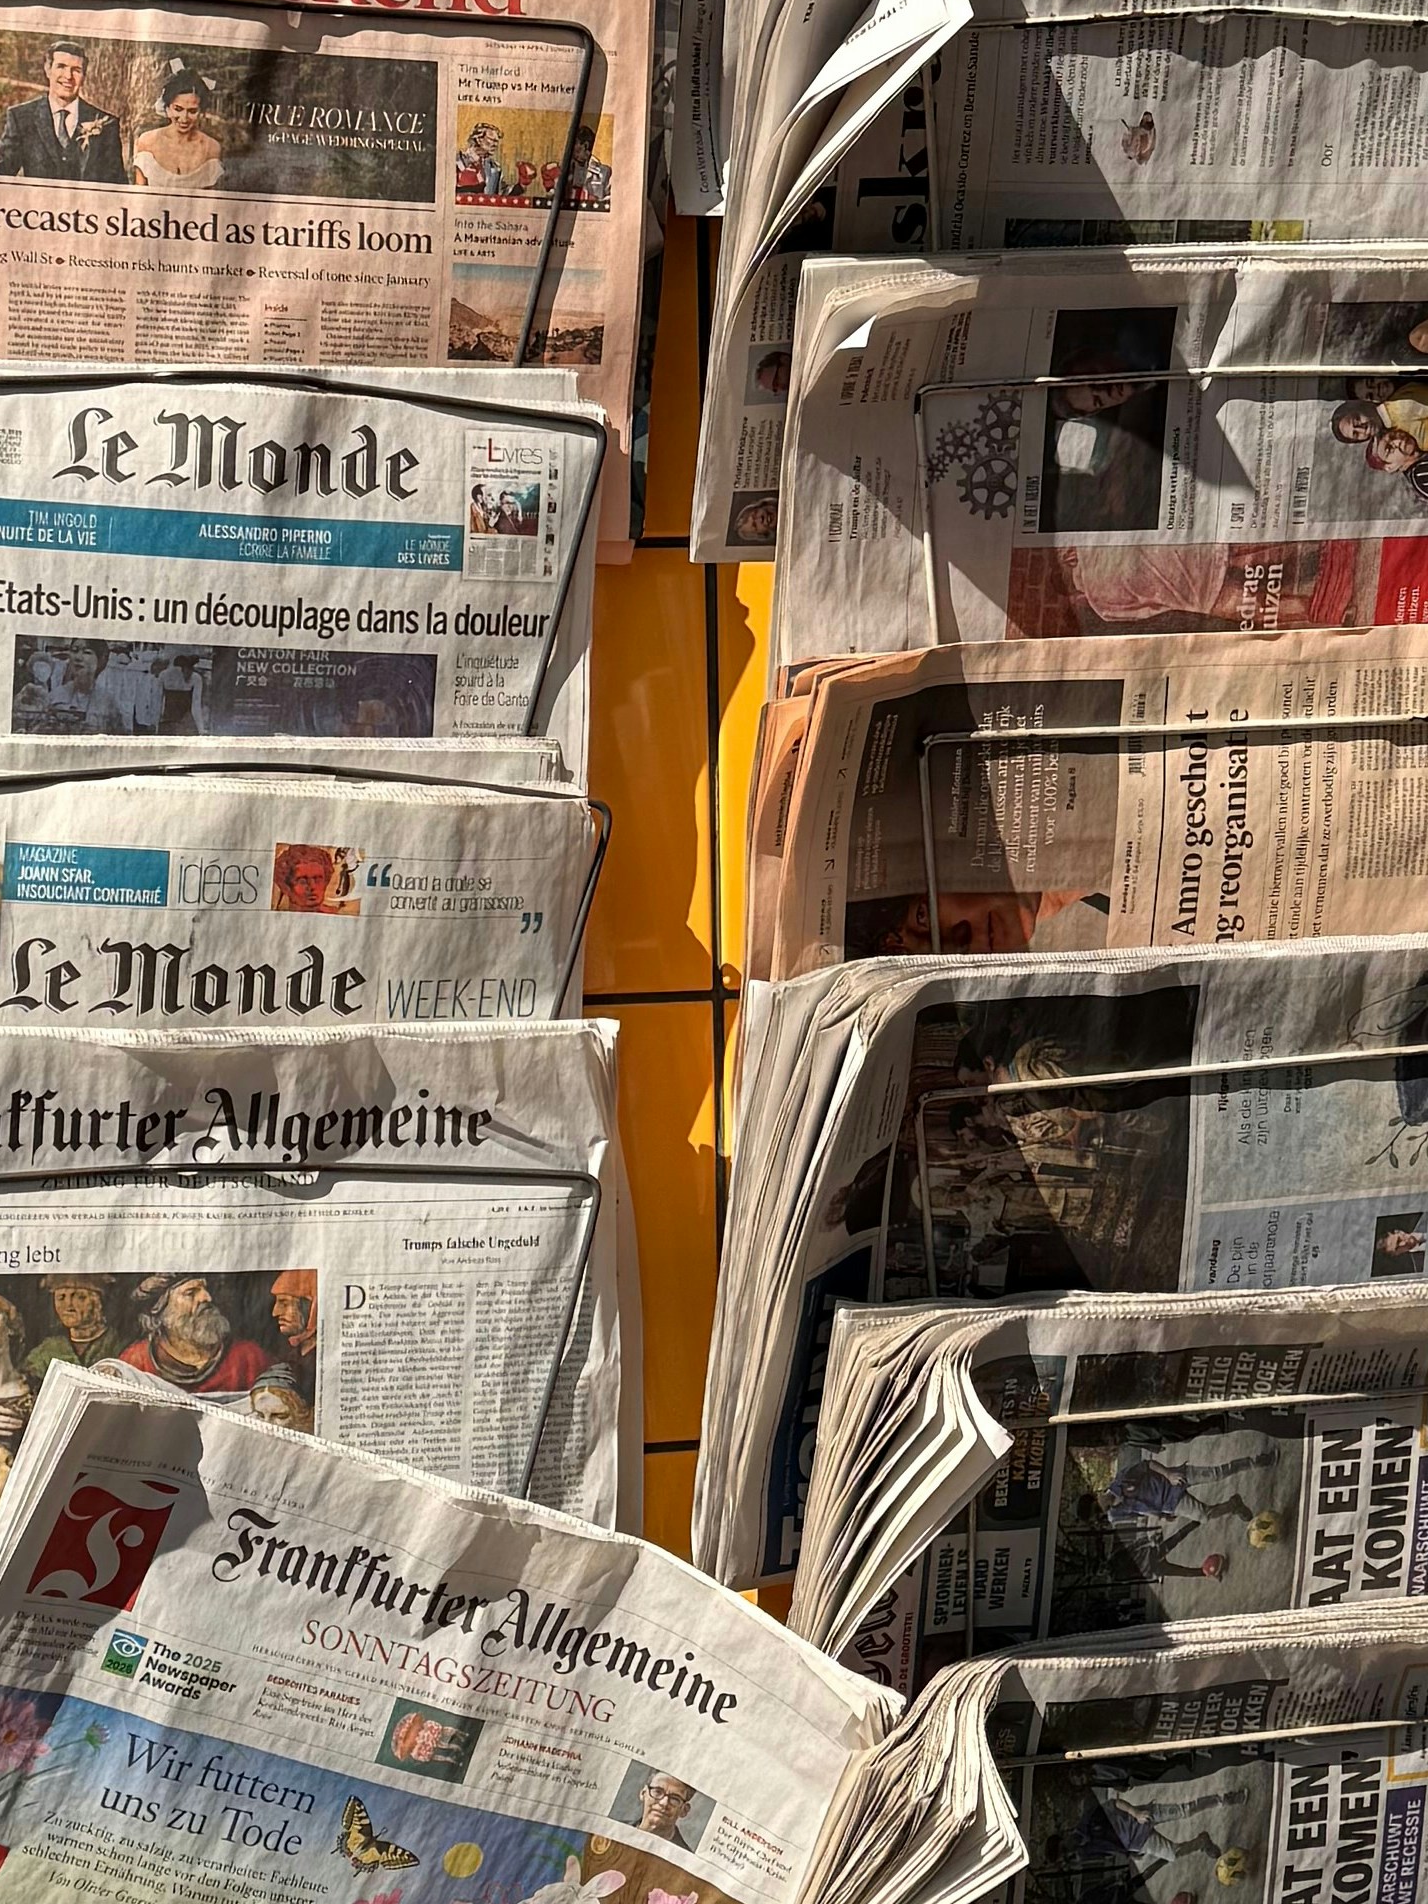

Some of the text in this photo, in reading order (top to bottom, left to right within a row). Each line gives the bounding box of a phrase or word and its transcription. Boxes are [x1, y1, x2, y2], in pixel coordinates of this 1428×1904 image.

[246, 102, 305, 127] TRUE
[310, 107, 425, 134] ROMANCE
[953, 130, 973, 211] Ocasio-Cortez
[105, 207, 218, 244] slashed
[225, 220, 254, 246] as
[263, 219, 350, 251] tariffs
[357, 220, 432, 255] loom
[69, 253, 430, 287] Recession risk haunts market Reversal January
[52, 408, 139, 485] Le
[146, 408, 419, 501] Monde
[38, 528, 97, 545] DE VIE
[199, 524, 332, 545] ALESSANDRO PIPERNO
[154, 598, 187, 624] un
[196, 593, 350, 639] découplage
[357, 601, 418, 634] dans
[426, 603, 447, 635] la
[454, 605, 550, 638] douleur
[273, 663, 357, 677] COLLECTION
[17, 867, 58, 882] JOANN
[17, 884, 161, 904] INSOUCIANT CONTRARIÉ
[177, 856, 259, 904] idées
[1171, 853, 1203, 936] Amro
[89, 937, 366, 1018] Monde
[387, 978, 537, 1019] WEEK-END
[192, 1087, 492, 1164] Allgemeine
[26, 1246, 61, 1264] lebt
[402, 1237, 443, 1252] Trumps
[488, 1234, 540, 1251] Ungeduld
[1317, 1427, 1364, 1517] EEN
[933, 1541, 955, 1626] SPIONNEN-
[988, 1547, 1010, 1610] WERKEN
[212, 1508, 738, 1724] Frankfurter Allgemeine
[145, 1656, 237, 1695] Newspaper
[152, 1641, 180, 1662] The
[301, 1619, 616, 1724] SONNTAGSZEITUNG
[139, 1672, 202, 1702] Awards
[125, 1732, 318, 1815] Wir futtern
[100, 1786, 304, 1857] uns zu Tode
[1286, 1766, 1330, 1851] EEN
[1398, 1798, 1423, 1877] RECESSIE
